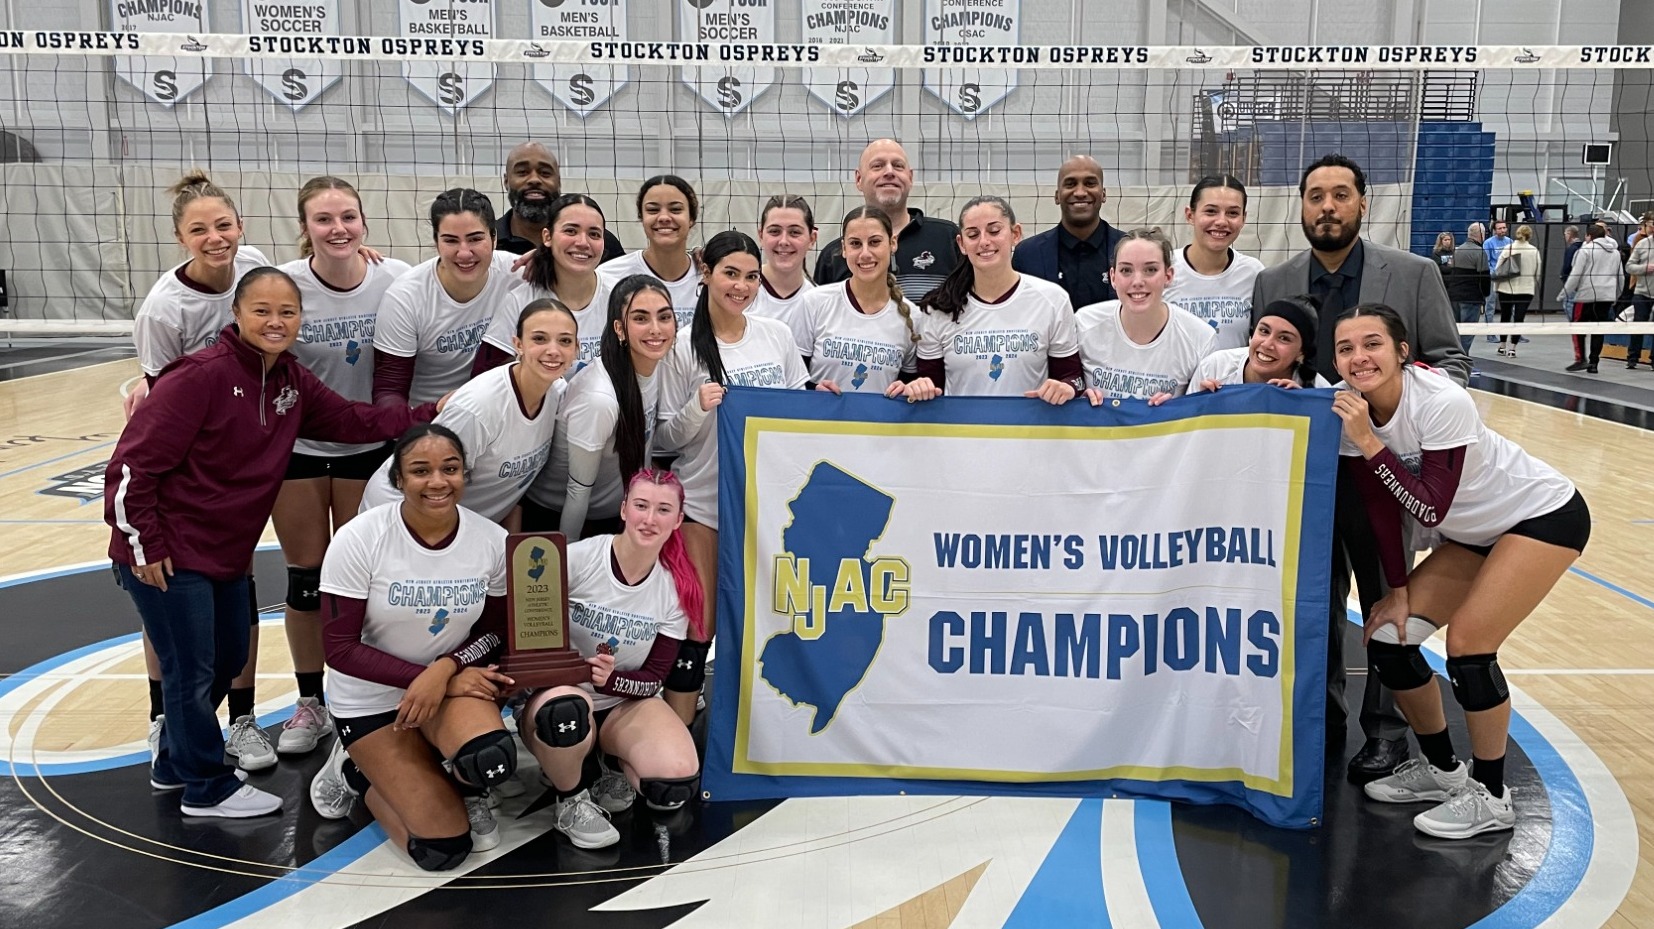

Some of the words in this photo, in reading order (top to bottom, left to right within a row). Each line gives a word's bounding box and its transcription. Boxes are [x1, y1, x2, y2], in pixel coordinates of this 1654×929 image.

[118, 0, 203, 19] CHAMPIONS
[255, 5, 326, 18] WOMEN'S
[560, 12, 599, 23] MEN'S
[261, 19, 322, 32] SOCCER
[706, 13, 750, 25] MEN'S
[807, 10, 889, 30] CHAMPIONS
[932, 11, 1013, 31] CHAMPIONS
[409, 23, 489, 34] BASKETBALL
[541, 26, 620, 37] BASKETBALL
[700, 27, 757, 39] SOCCER
[834, 25, 861, 33] NJAC
[35, 32, 139, 49] OSPREYS
[249, 36, 371, 54] STOCKTON
[382, 38, 484, 56] OSPREYS
[591, 42, 709, 60] STOCKTON
[720, 44, 819, 61] OSPREYS
[924, 46, 1040, 63] STOCKTON
[1049, 47, 1149, 63] OSPREYS
[1252, 47, 1369, 63] STOCKTON
[1378, 47, 1477, 63] OSPREYS
[1580, 47, 1653, 63] STOCK
[302, 318, 376, 343] CHAMPIO
[954, 332, 1039, 354] CHAMPIONS
[823, 338, 904, 368] CHAMPIONS
[933, 531, 1085, 570] WOMEN'S
[1099, 527, 1277, 570] VOLLEYBALL
[388, 580, 486, 607] CHAMPIONS
[526, 585, 549, 593] 2023
[772, 555, 912, 641] NJAC
[572, 602, 661, 641] CHAMPIONS
[520, 630, 559, 639] CHAMPIONS
[927, 606, 1281, 680] CHAMPIONS
